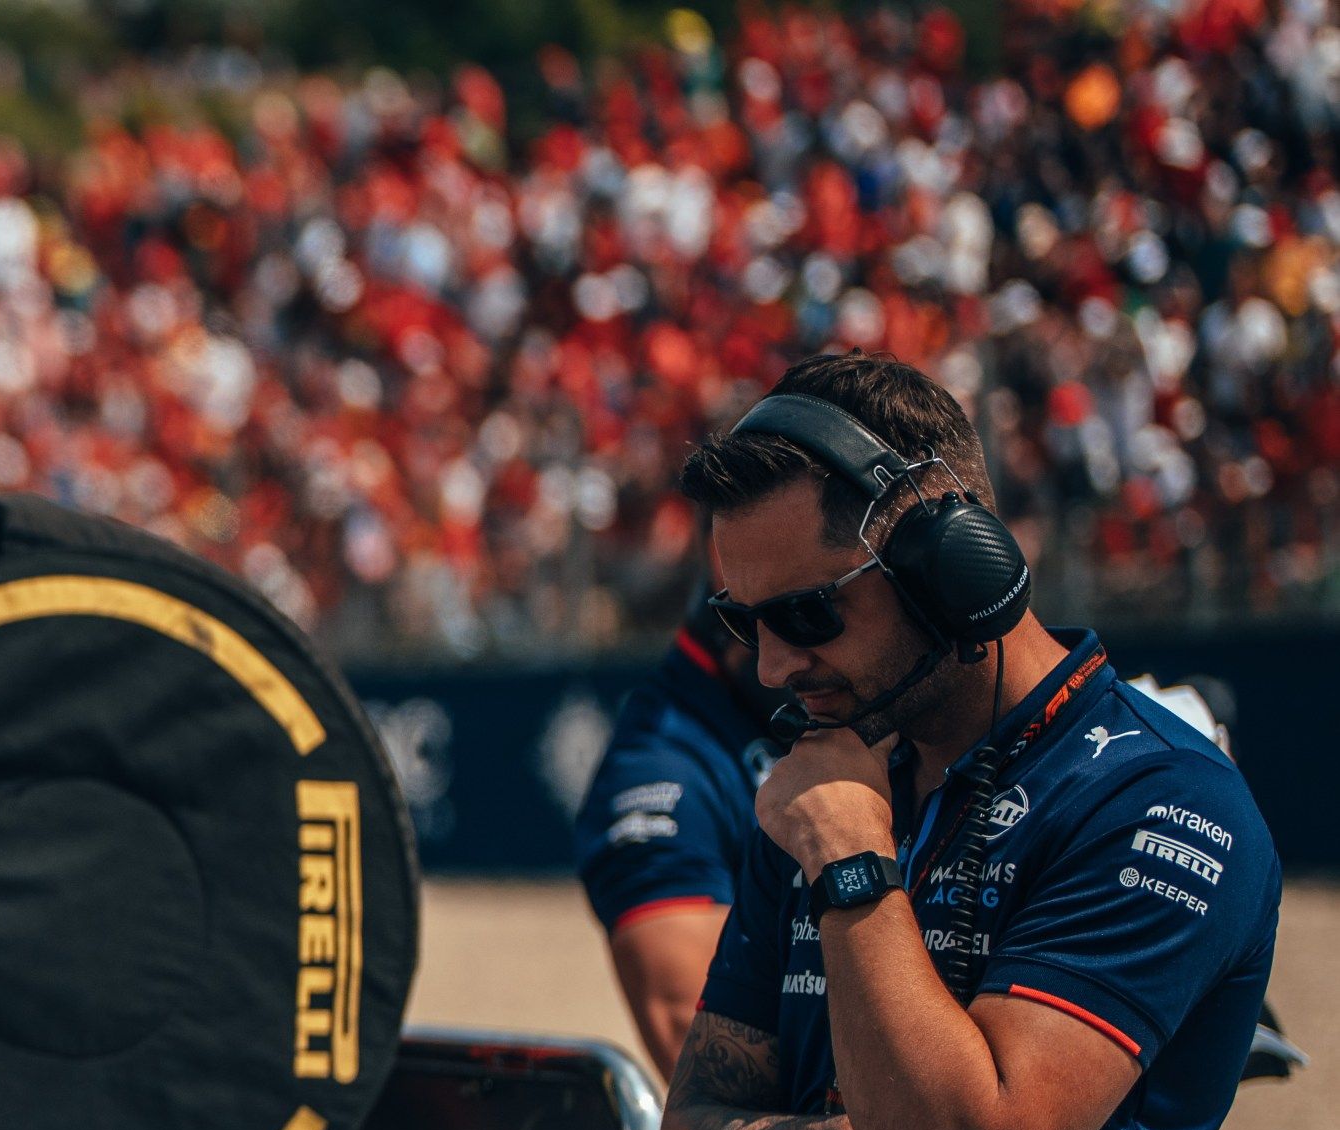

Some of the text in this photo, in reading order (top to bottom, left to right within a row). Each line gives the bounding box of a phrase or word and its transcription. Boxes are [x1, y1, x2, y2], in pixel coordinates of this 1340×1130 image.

[969, 590, 1015, 622] WILLIAMS
[1167, 804, 1233, 852] kraken
[1130, 828, 1224, 886] PIRELLI
[1140, 875, 1209, 916] KEEPER
[294, 779, 363, 1084] PIRELLI
